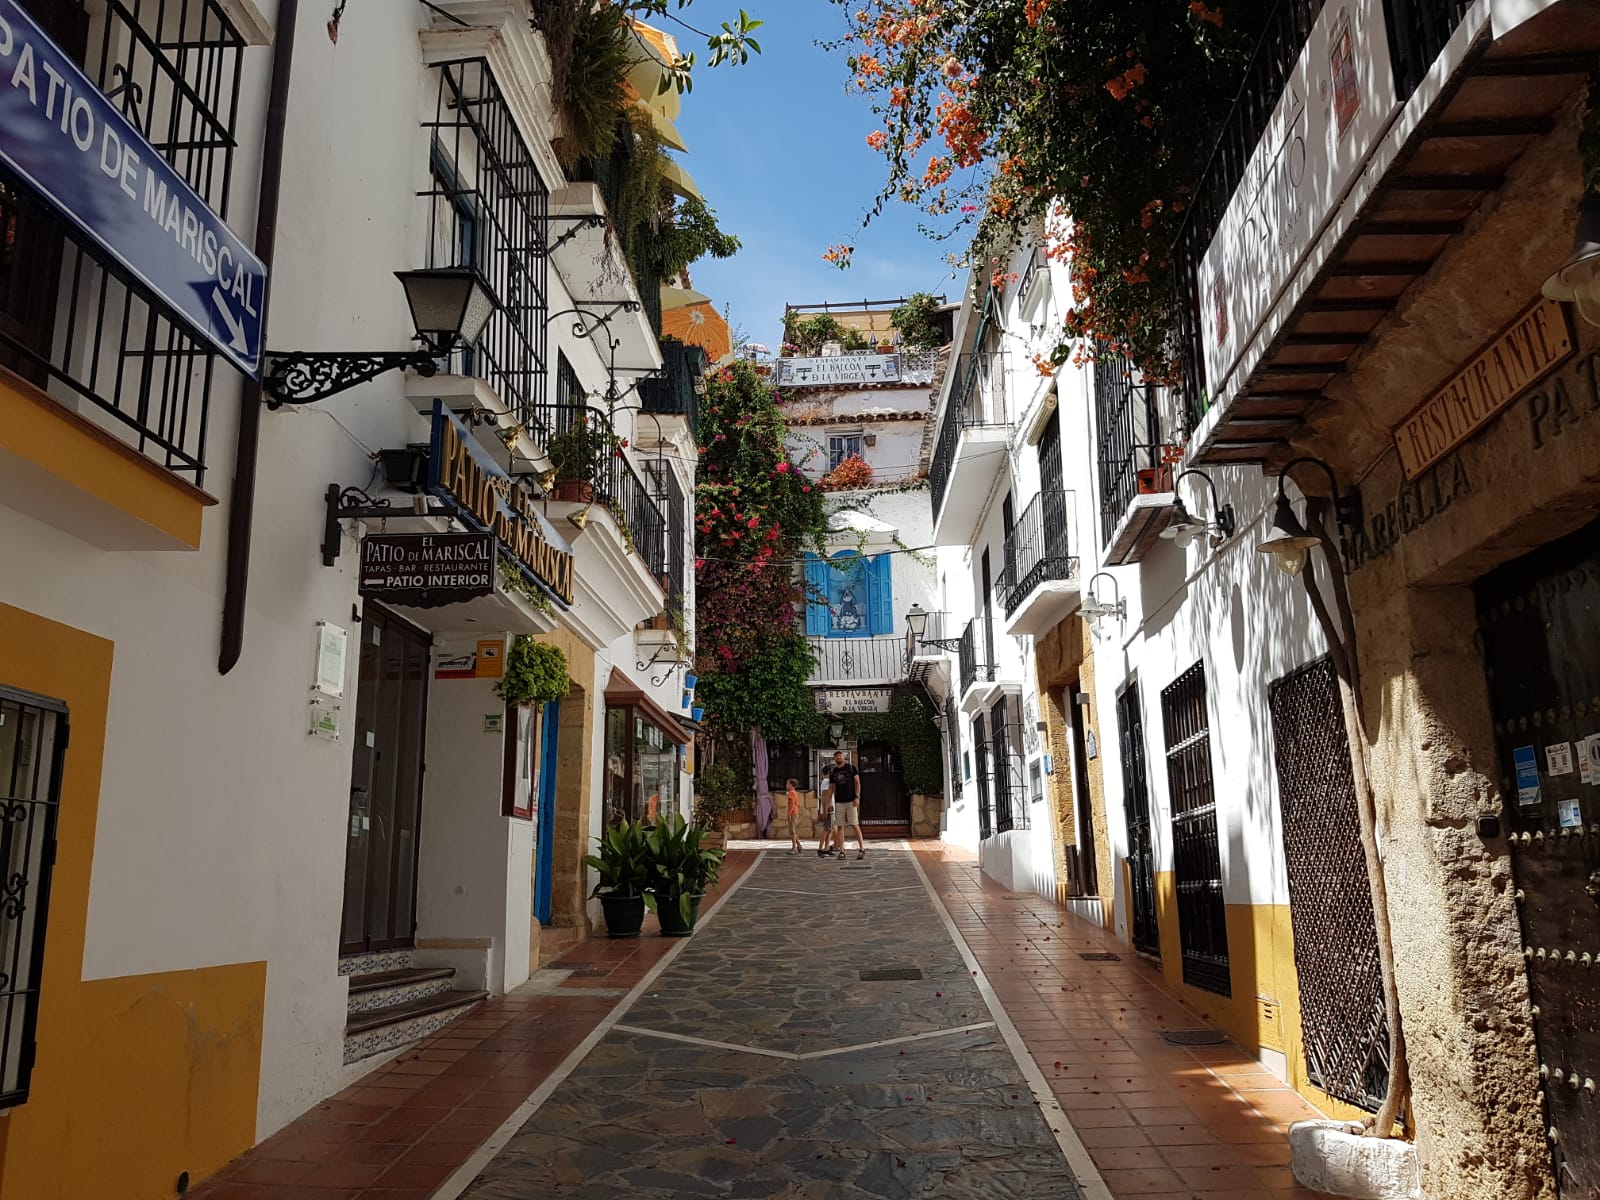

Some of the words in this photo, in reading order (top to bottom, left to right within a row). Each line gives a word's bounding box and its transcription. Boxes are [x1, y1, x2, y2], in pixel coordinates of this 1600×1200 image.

[100, 123, 141, 201] DE
[143, 167, 257, 318] MARISCAL
[816, 364, 825, 372] EL
[829, 363, 861, 373] BALCON
[822, 373, 831, 383] LA
[835, 372, 866, 381] VIRGEN
[1407, 305, 1557, 469] RESTAURANTE
[440, 417, 497, 528] PATIO
[422, 537, 435, 547] EL
[366, 541, 404, 562] PATIO
[408, 552, 419, 561] DE
[422, 540, 489, 560] MARISCAL
[499, 512, 513, 548] DE
[514, 516, 575, 605] MARISCAL
[364, 565, 392, 574] TAPAS
[399, 565, 416, 573] BAR
[424, 563, 489, 572] RESTAURANTE
[387, 576, 424, 587] PATIO
[428, 574, 489, 586] INTERIOR
